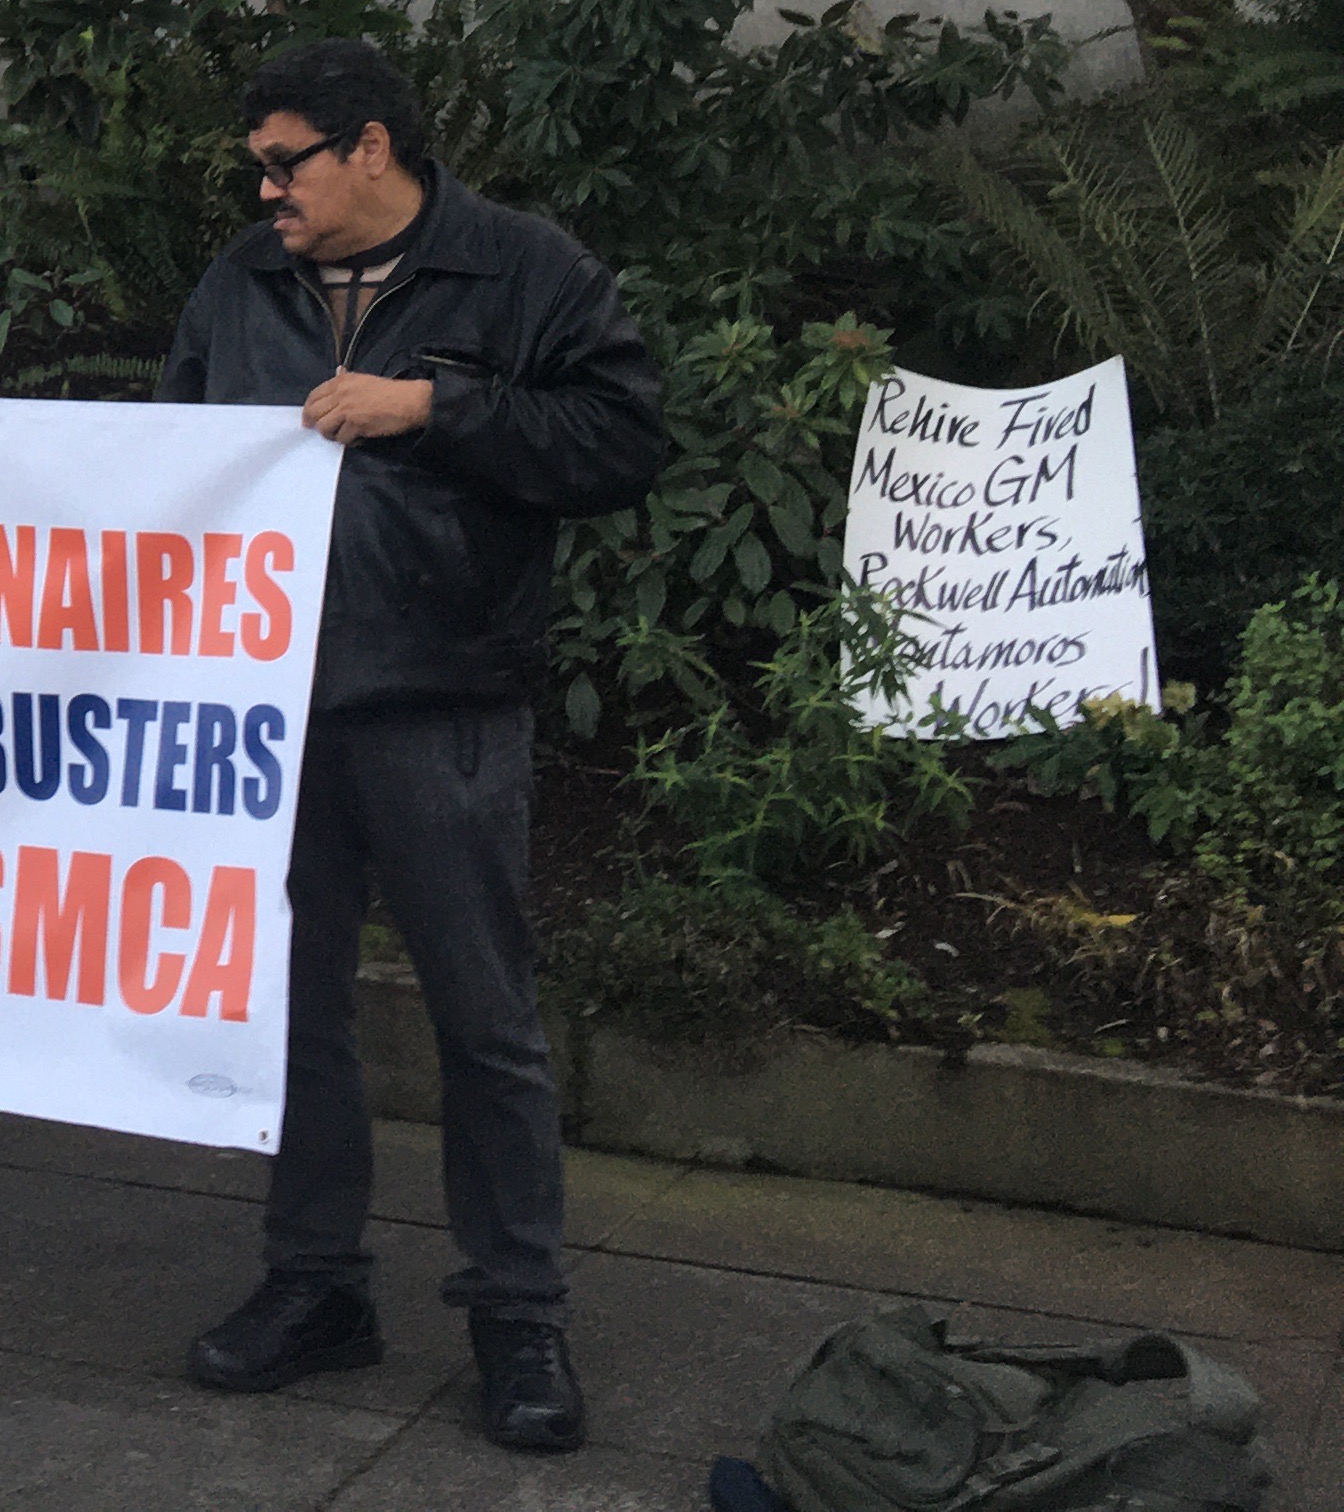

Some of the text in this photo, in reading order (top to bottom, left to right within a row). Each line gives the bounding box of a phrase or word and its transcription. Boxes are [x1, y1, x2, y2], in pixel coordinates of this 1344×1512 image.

[868, 377, 1096, 450] Rehire Fired
[853, 443, 1079, 510] Mexico GM
[892, 510, 1074, 557] Workers,
